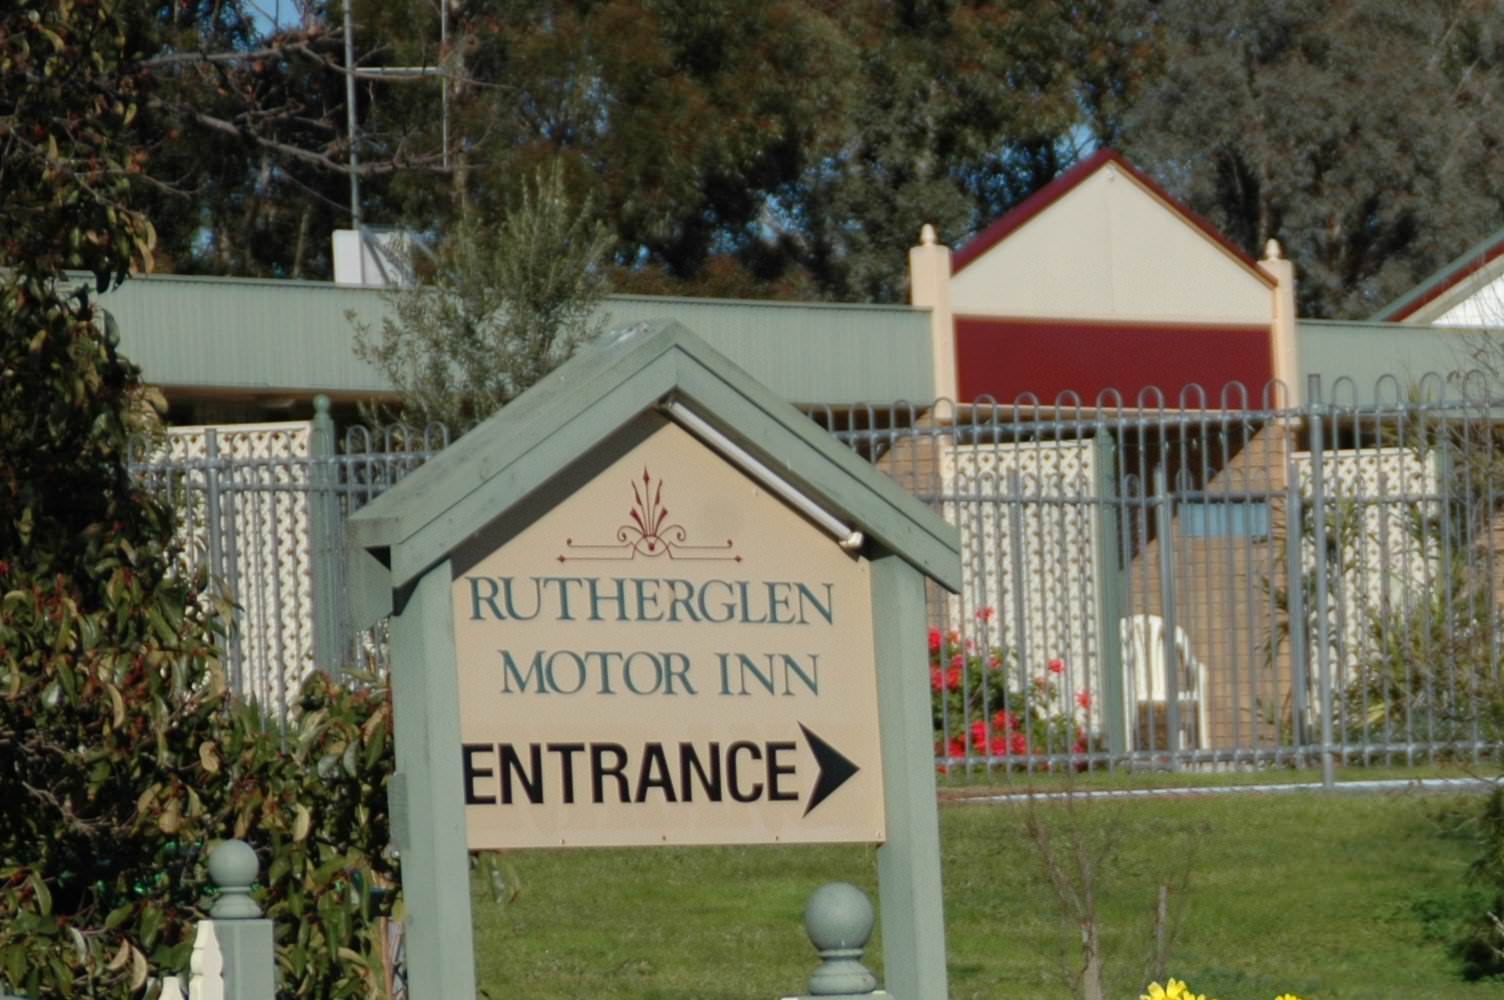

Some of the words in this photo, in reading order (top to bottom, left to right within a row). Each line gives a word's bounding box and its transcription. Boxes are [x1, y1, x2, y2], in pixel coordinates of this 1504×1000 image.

[465, 576, 834, 625] RUTHERGLEN
[498, 650, 698, 696] MOTOR
[714, 653, 821, 697] INN
[461, 740, 800, 806] ENTRANCE
